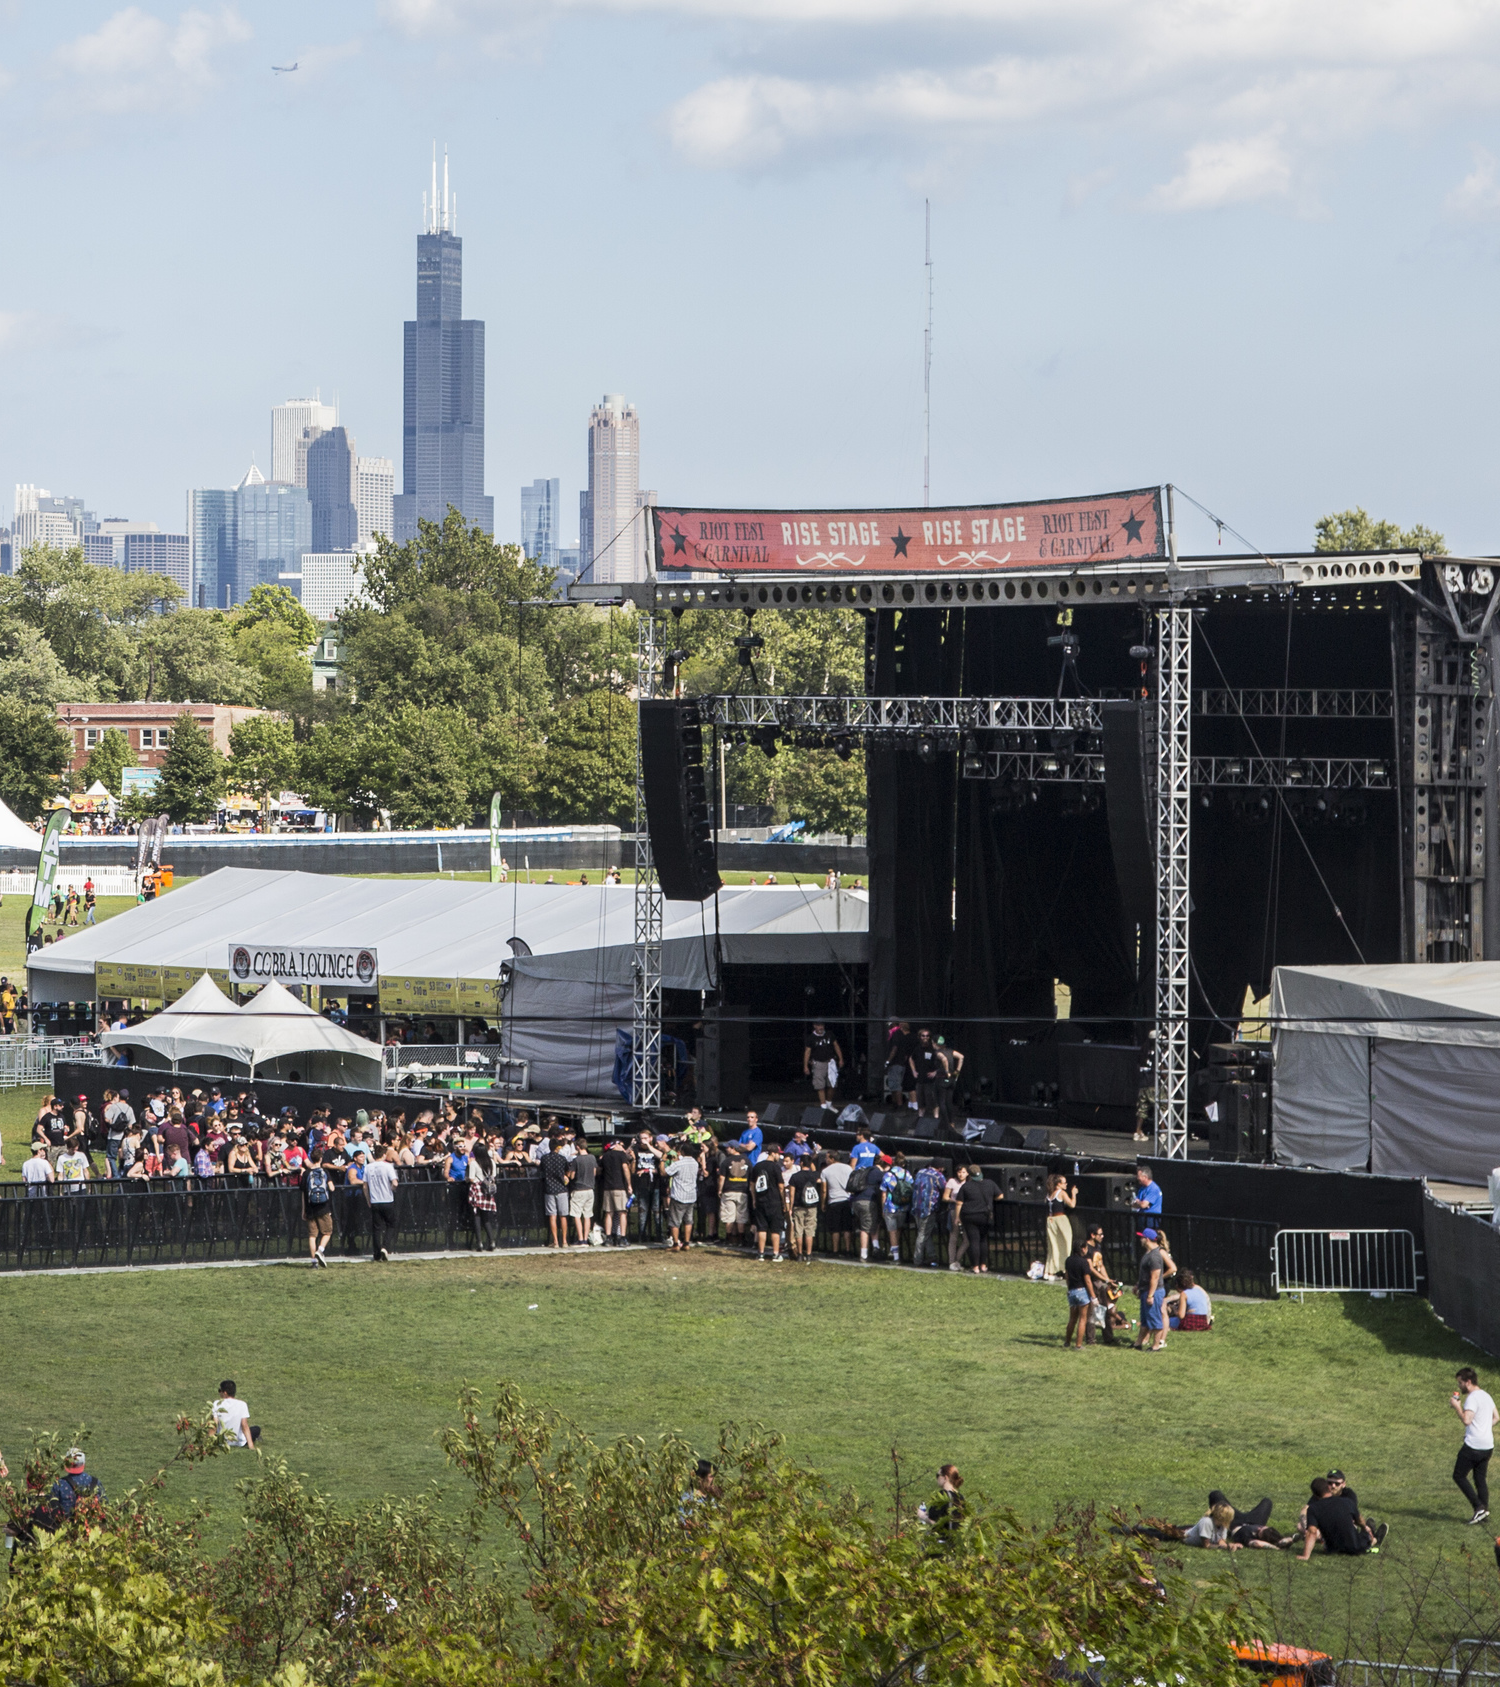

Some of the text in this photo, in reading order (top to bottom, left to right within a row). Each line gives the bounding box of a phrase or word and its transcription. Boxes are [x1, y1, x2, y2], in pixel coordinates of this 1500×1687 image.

[699, 521, 765, 541] RIOT FEST
[781, 521, 881, 546] RISE STAGE
[923, 516, 1027, 546] RISE STAGE
[1042, 509, 1111, 535] RIOT FEST
[703, 543, 770, 563] CARNIVAL
[1050, 534, 1115, 558] CARNIVAL
[33, 828, 60, 909] ATM
[253, 951, 354, 981] COBRA LOUNGE
